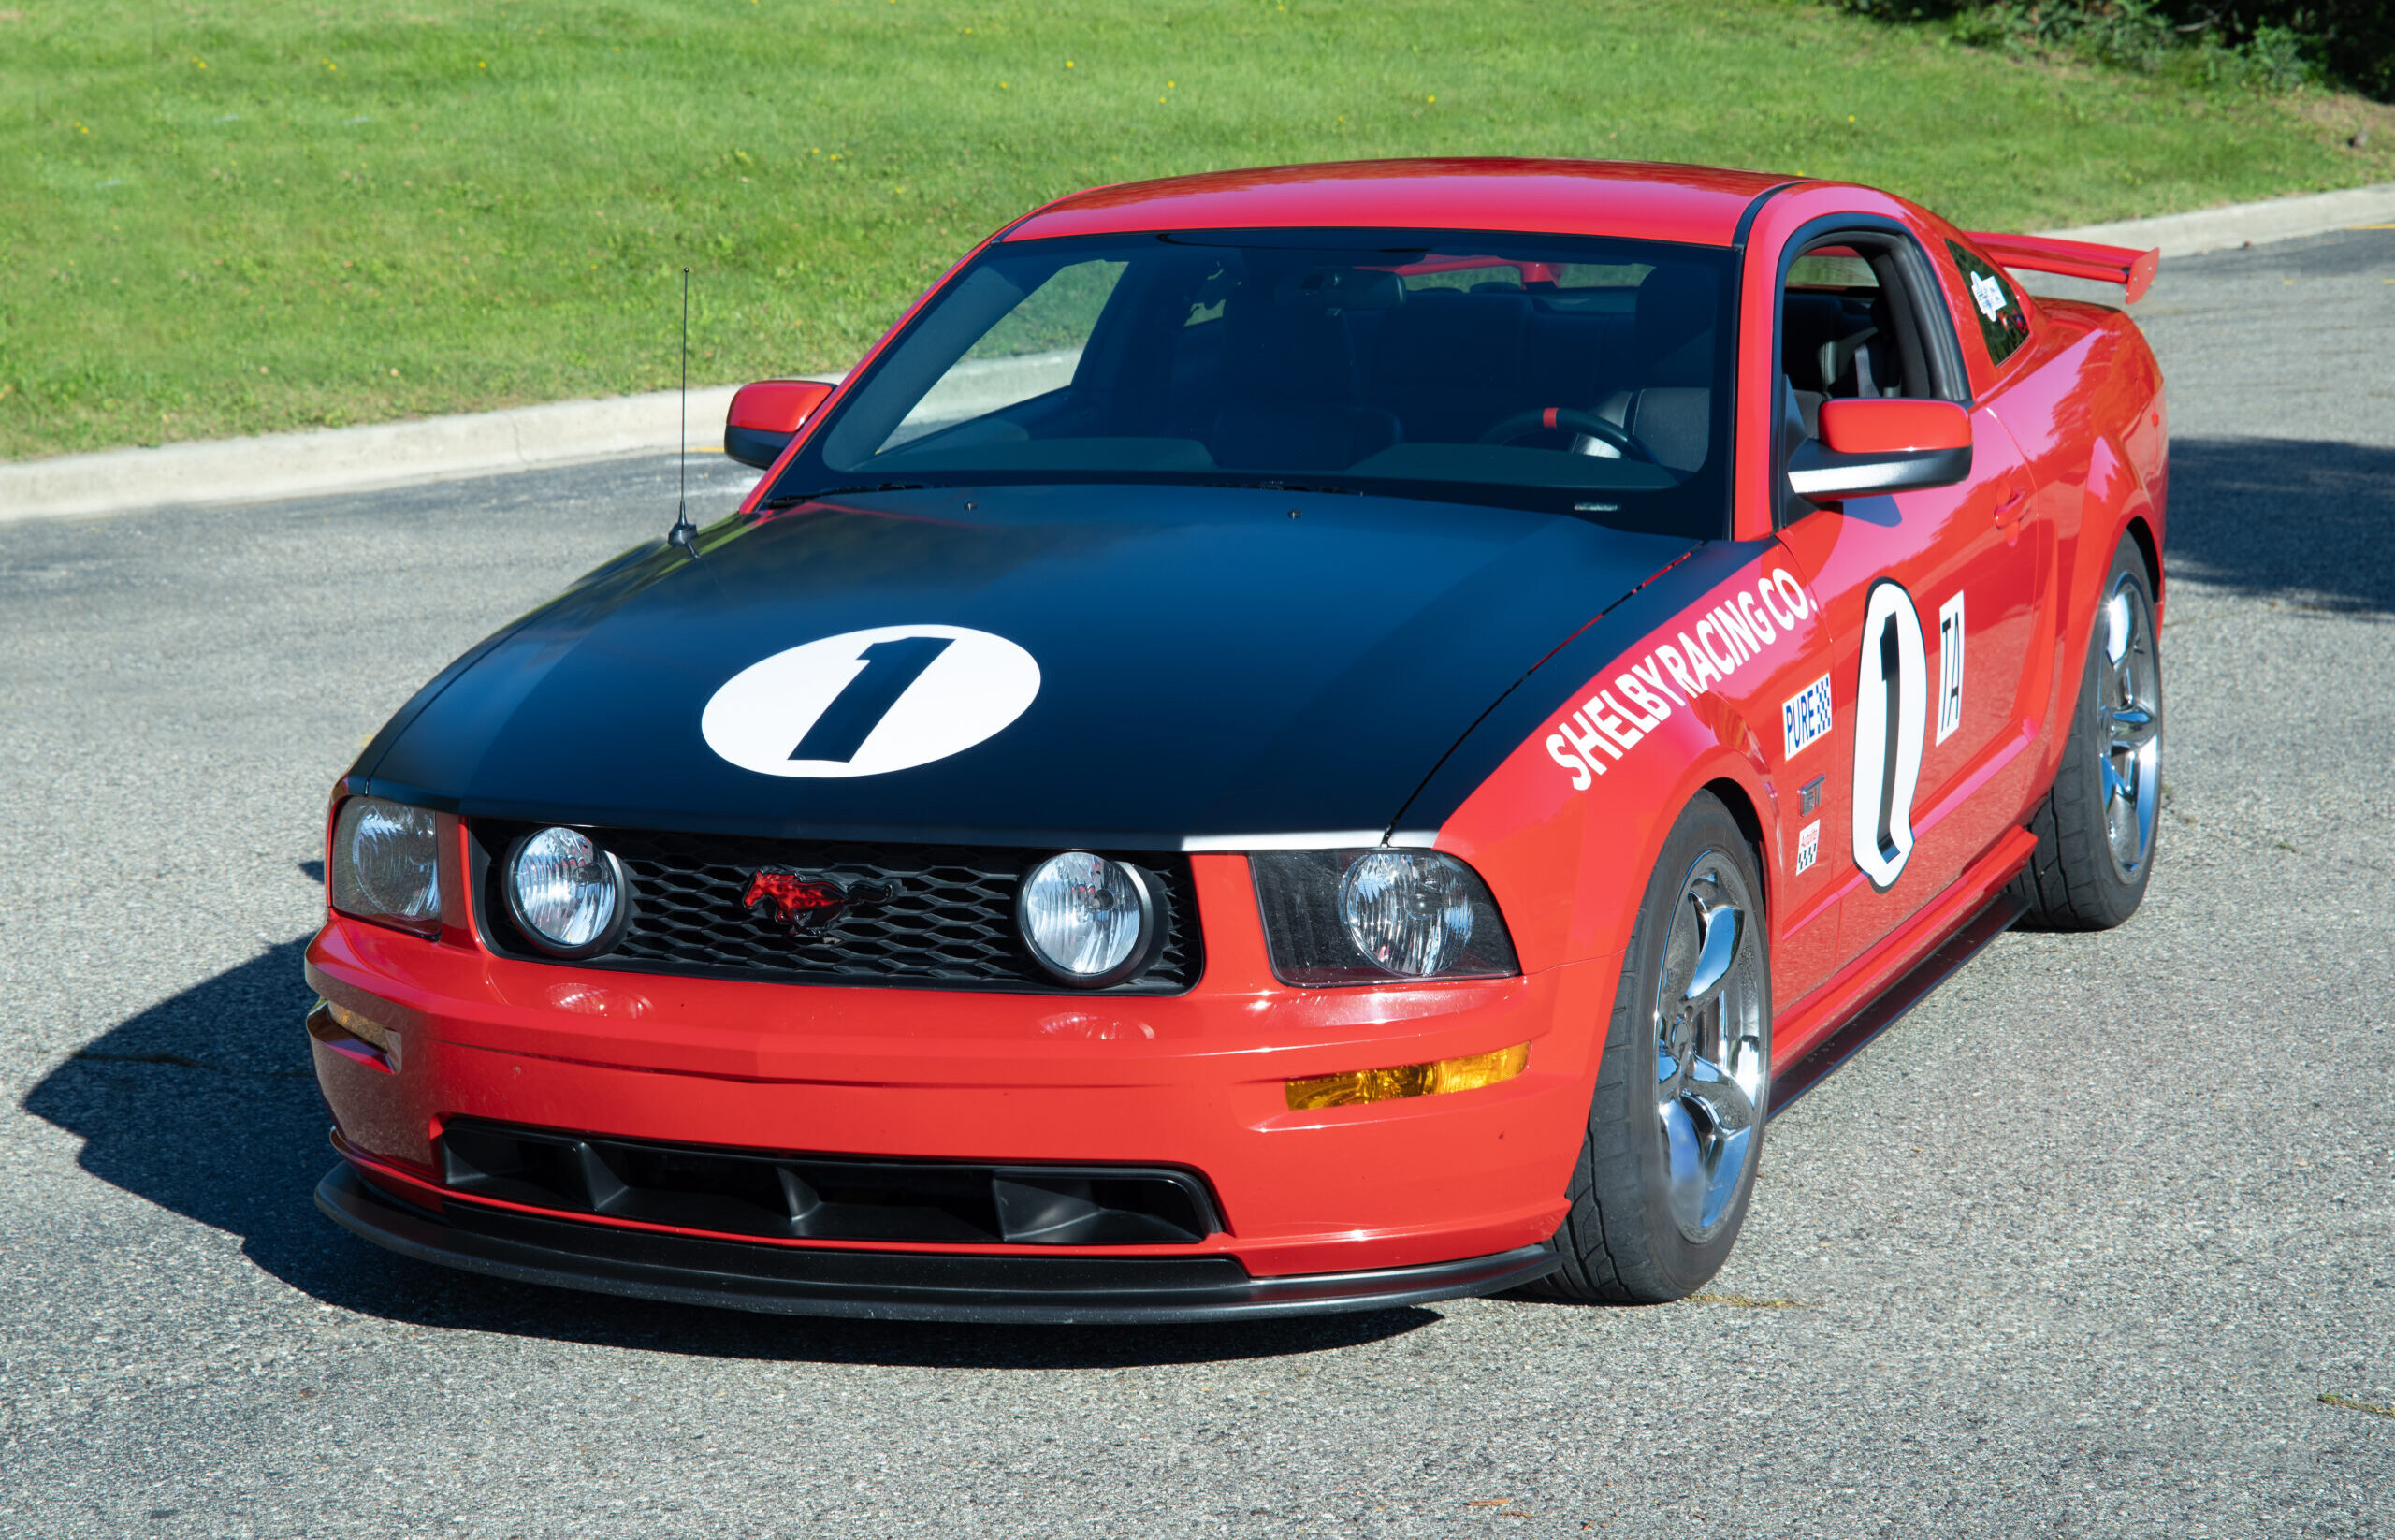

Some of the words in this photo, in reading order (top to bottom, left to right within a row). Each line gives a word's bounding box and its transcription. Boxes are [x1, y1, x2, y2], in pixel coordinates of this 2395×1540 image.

[786, 635, 957, 763] 1
[1546, 655, 1686, 791] SHELBY
[1654, 591, 1777, 699] RACING
[1758, 568, 1818, 631] CO.
[1786, 690, 1815, 754] PURE
[1940, 611, 1960, 733] TA
[1799, 772, 1825, 817] GT
[1877, 610, 1901, 864] 1
